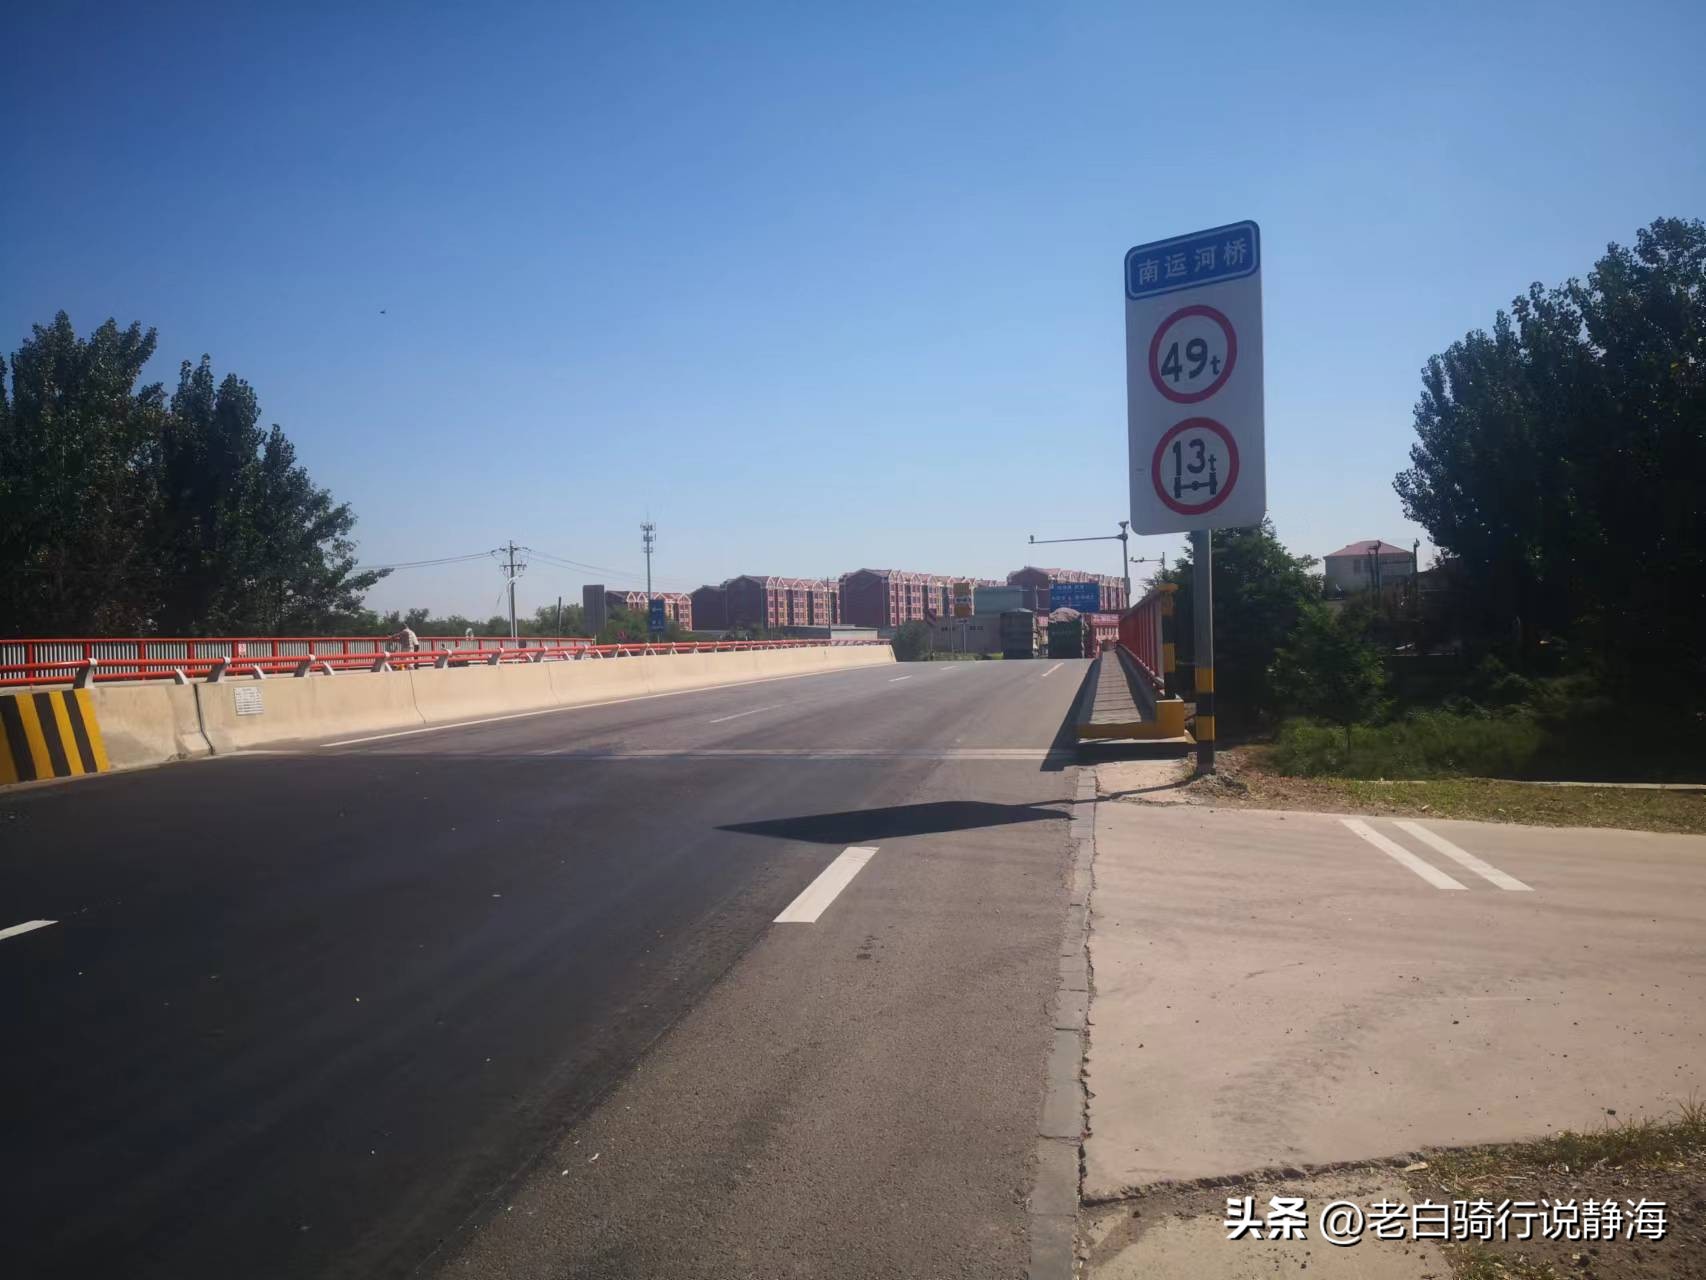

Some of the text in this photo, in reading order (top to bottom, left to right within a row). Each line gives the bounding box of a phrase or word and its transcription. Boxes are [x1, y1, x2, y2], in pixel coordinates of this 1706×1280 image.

[1137, 238, 1247, 285] 南运河桥
[1161, 338, 1221, 382] 49t
[1172, 438, 1217, 476] 13t
